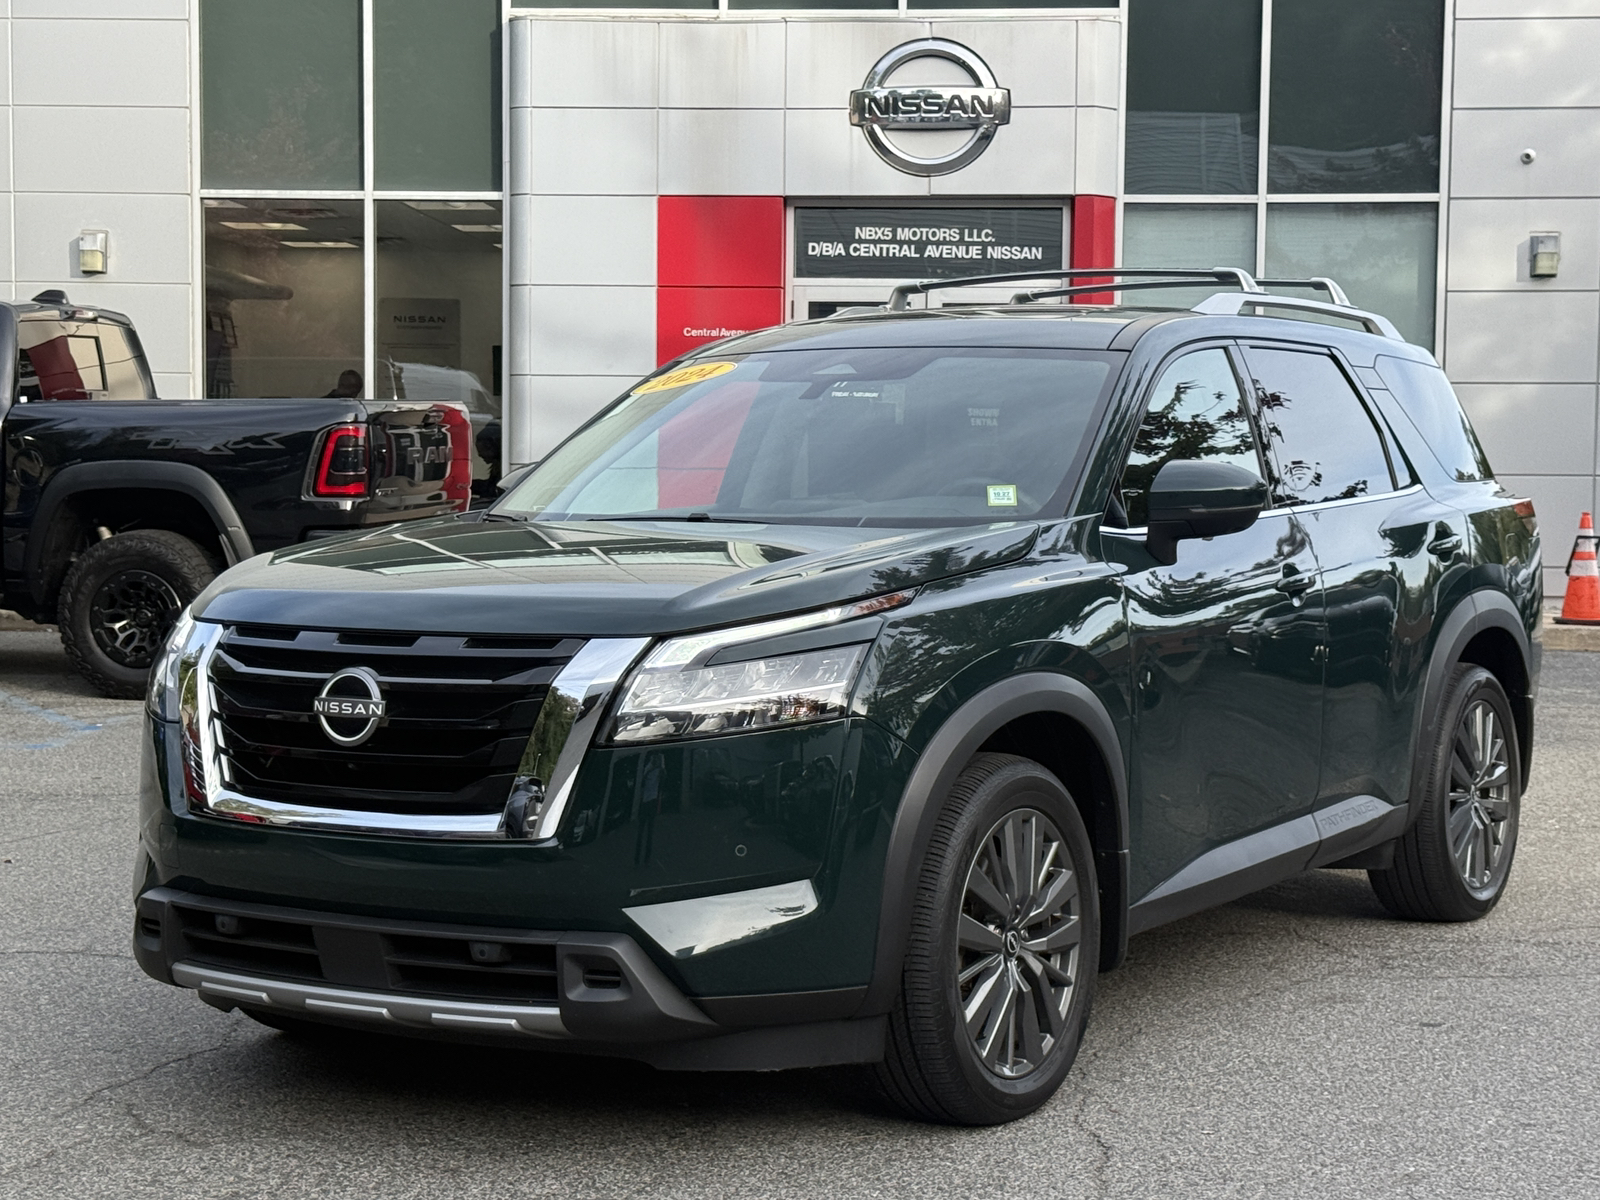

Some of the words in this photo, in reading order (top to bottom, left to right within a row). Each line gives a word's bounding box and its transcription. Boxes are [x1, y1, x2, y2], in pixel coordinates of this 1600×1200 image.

[864, 94, 995, 119] NISSAN
[855, 226, 893, 241] NBX5
[896, 227, 960, 242] MOTORS
[964, 228, 996, 243] LLC.
[807, 242, 846, 258] D/B/A
[849, 243, 920, 258] CENTRAL
[923, 245, 983, 259] AVENUE
[987, 246, 1043, 260] NISSAN
[393, 315, 447, 324] NISSAN
[683, 327, 720, 337] Central
[406, 446, 453, 465] RAM
[314, 700, 383, 715] NISSAN
[1319, 800, 1379, 831] PATHFINDER
